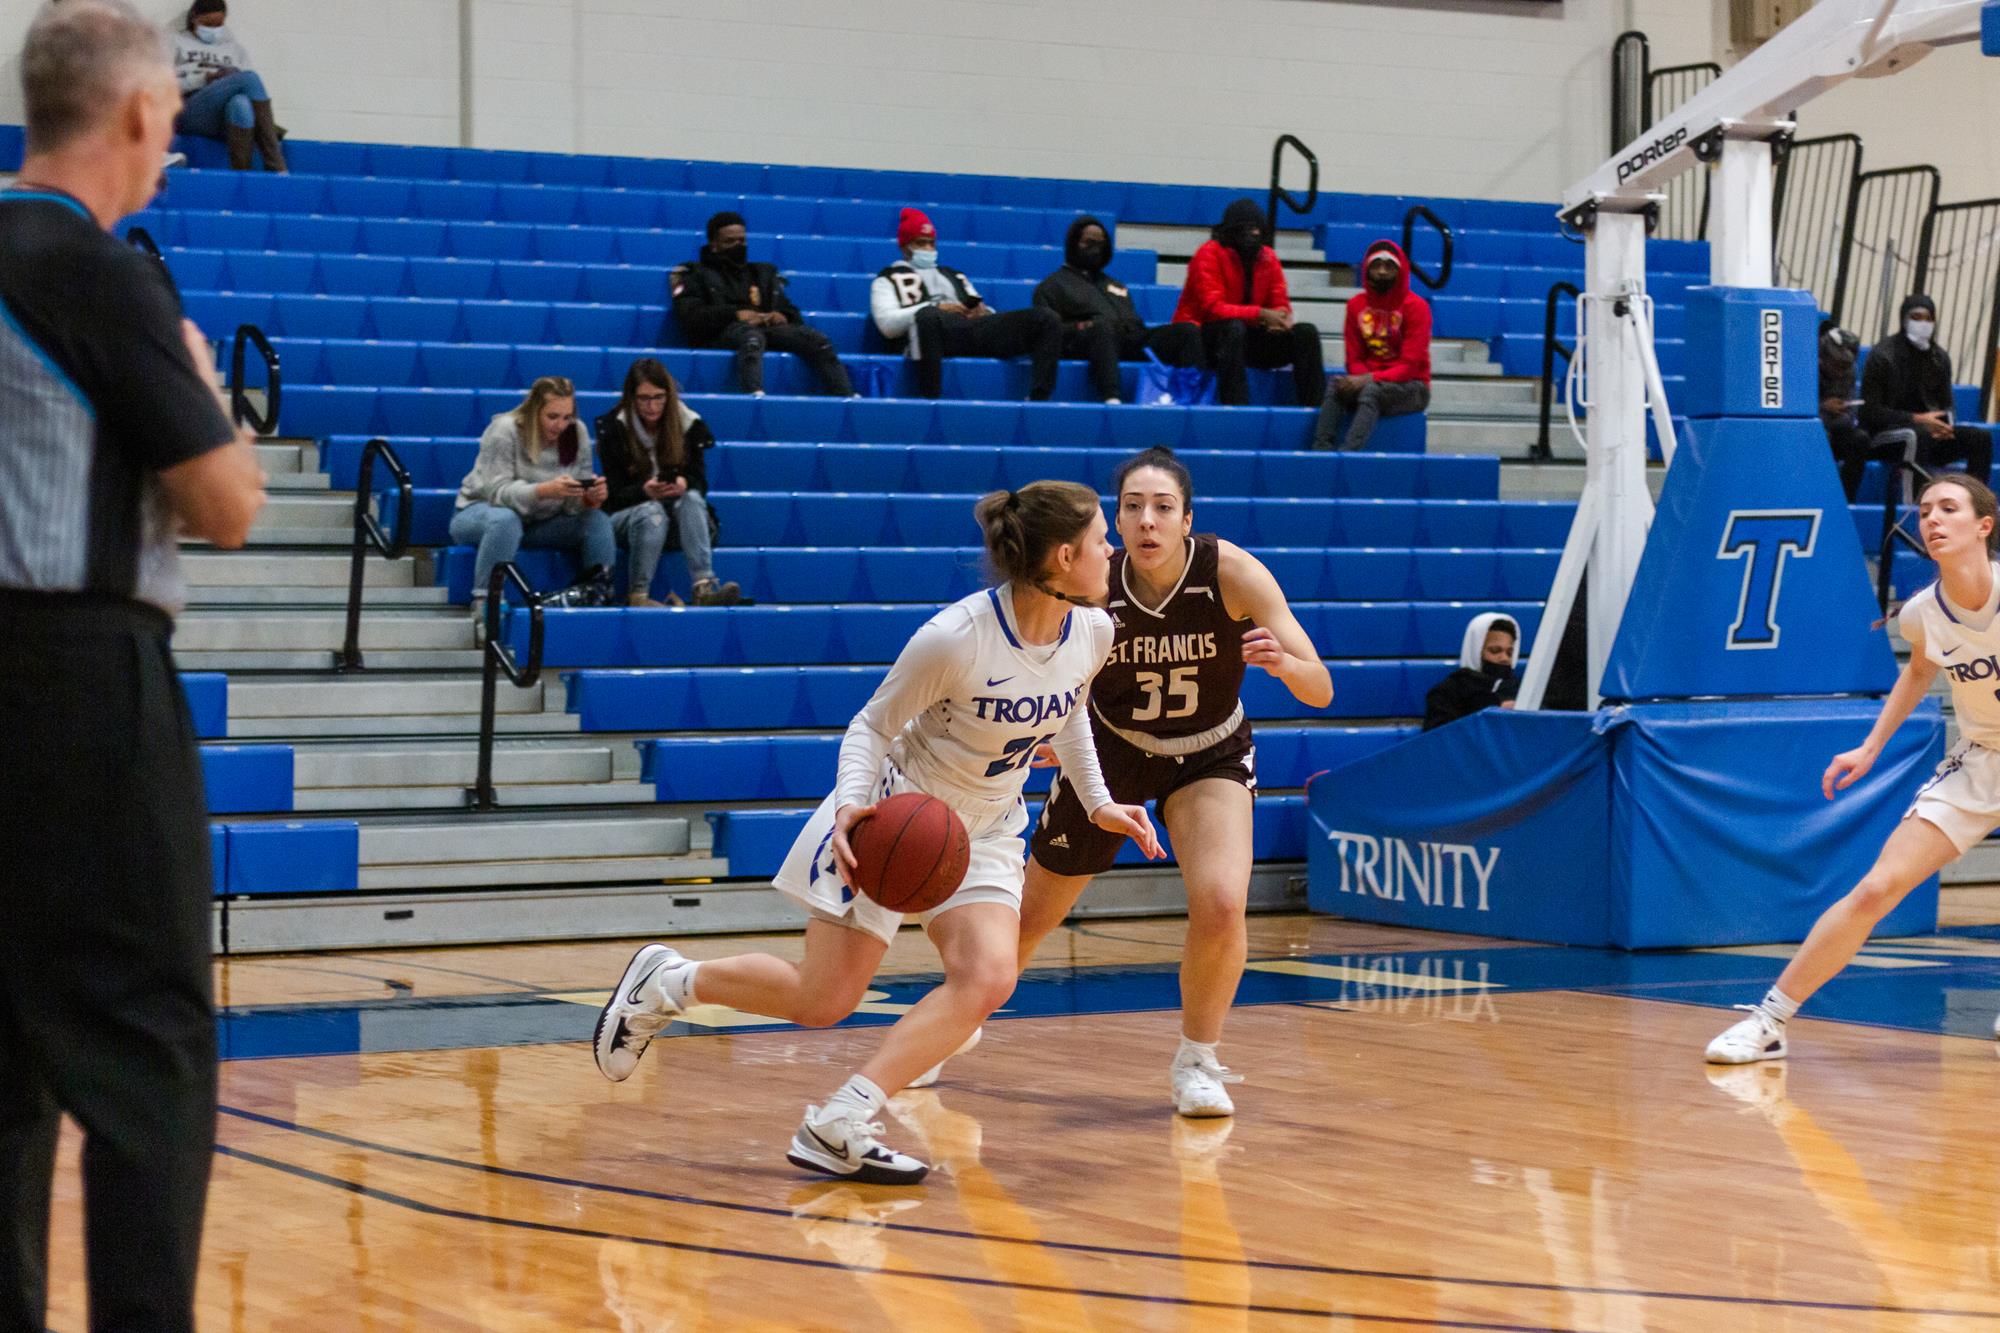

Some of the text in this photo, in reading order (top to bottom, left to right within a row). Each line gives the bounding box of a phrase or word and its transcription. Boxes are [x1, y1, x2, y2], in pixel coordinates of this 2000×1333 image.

[1715, 508, 1823, 650] T
[1106, 632, 1217, 666] ST. FRANCIS
[971, 683, 1085, 728] TROJAN
[1132, 666, 1199, 720] 35
[1328, 830, 1501, 911] TRINITY
